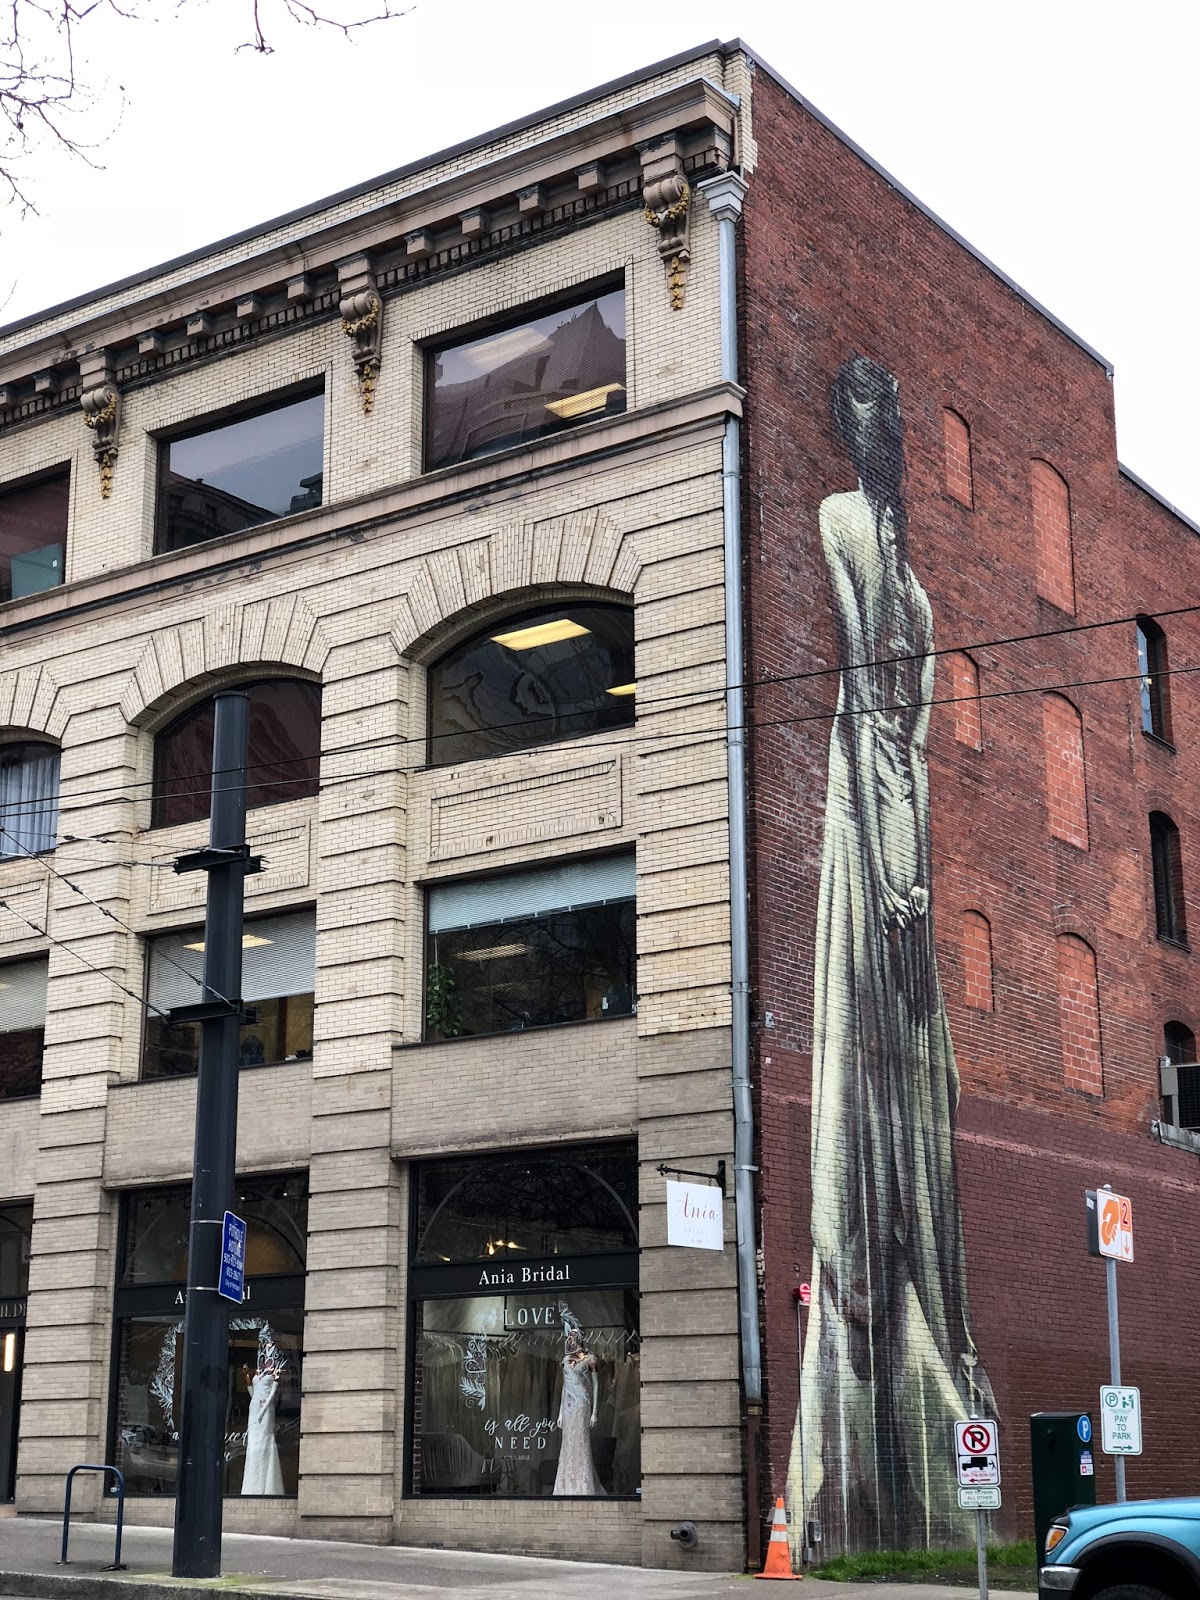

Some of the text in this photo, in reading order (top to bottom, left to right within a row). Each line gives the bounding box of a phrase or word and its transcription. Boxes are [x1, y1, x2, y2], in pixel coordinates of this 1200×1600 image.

[673, 1192, 717, 1221] Ania
[1122, 1202, 1129, 1225] 2
[479, 1264, 570, 1285] Ania Bridal
[504, 1307, 555, 1326] LOVE
[504, 1413, 531, 1433] all
[529, 1417, 557, 1438] you
[1114, 1415, 1128, 1423] PAY
[1116, 1423, 1127, 1432] TO
[494, 1436, 546, 1450] NEED
[1112, 1432, 1132, 1440] PARK
